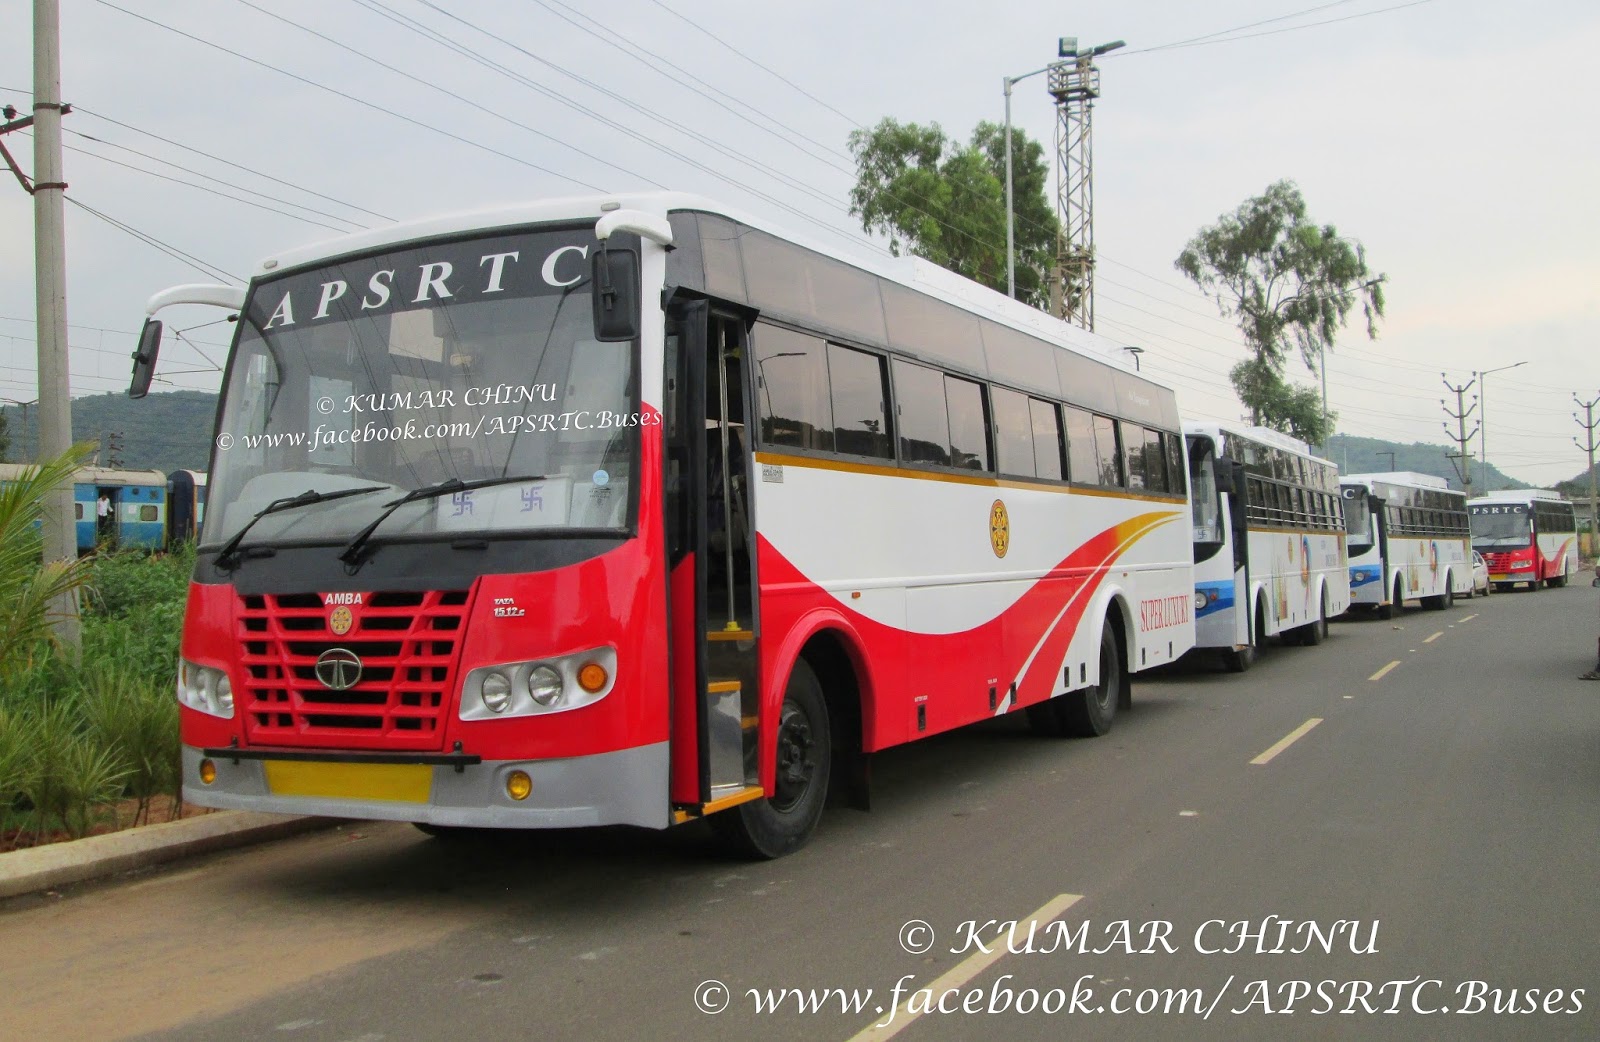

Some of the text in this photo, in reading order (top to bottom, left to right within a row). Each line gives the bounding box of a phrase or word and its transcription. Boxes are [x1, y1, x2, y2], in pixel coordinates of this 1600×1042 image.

[324, 593, 363, 605] AMBA
[493, 597, 515, 605] TATA
[1140, 598, 1164, 632] SUPER
